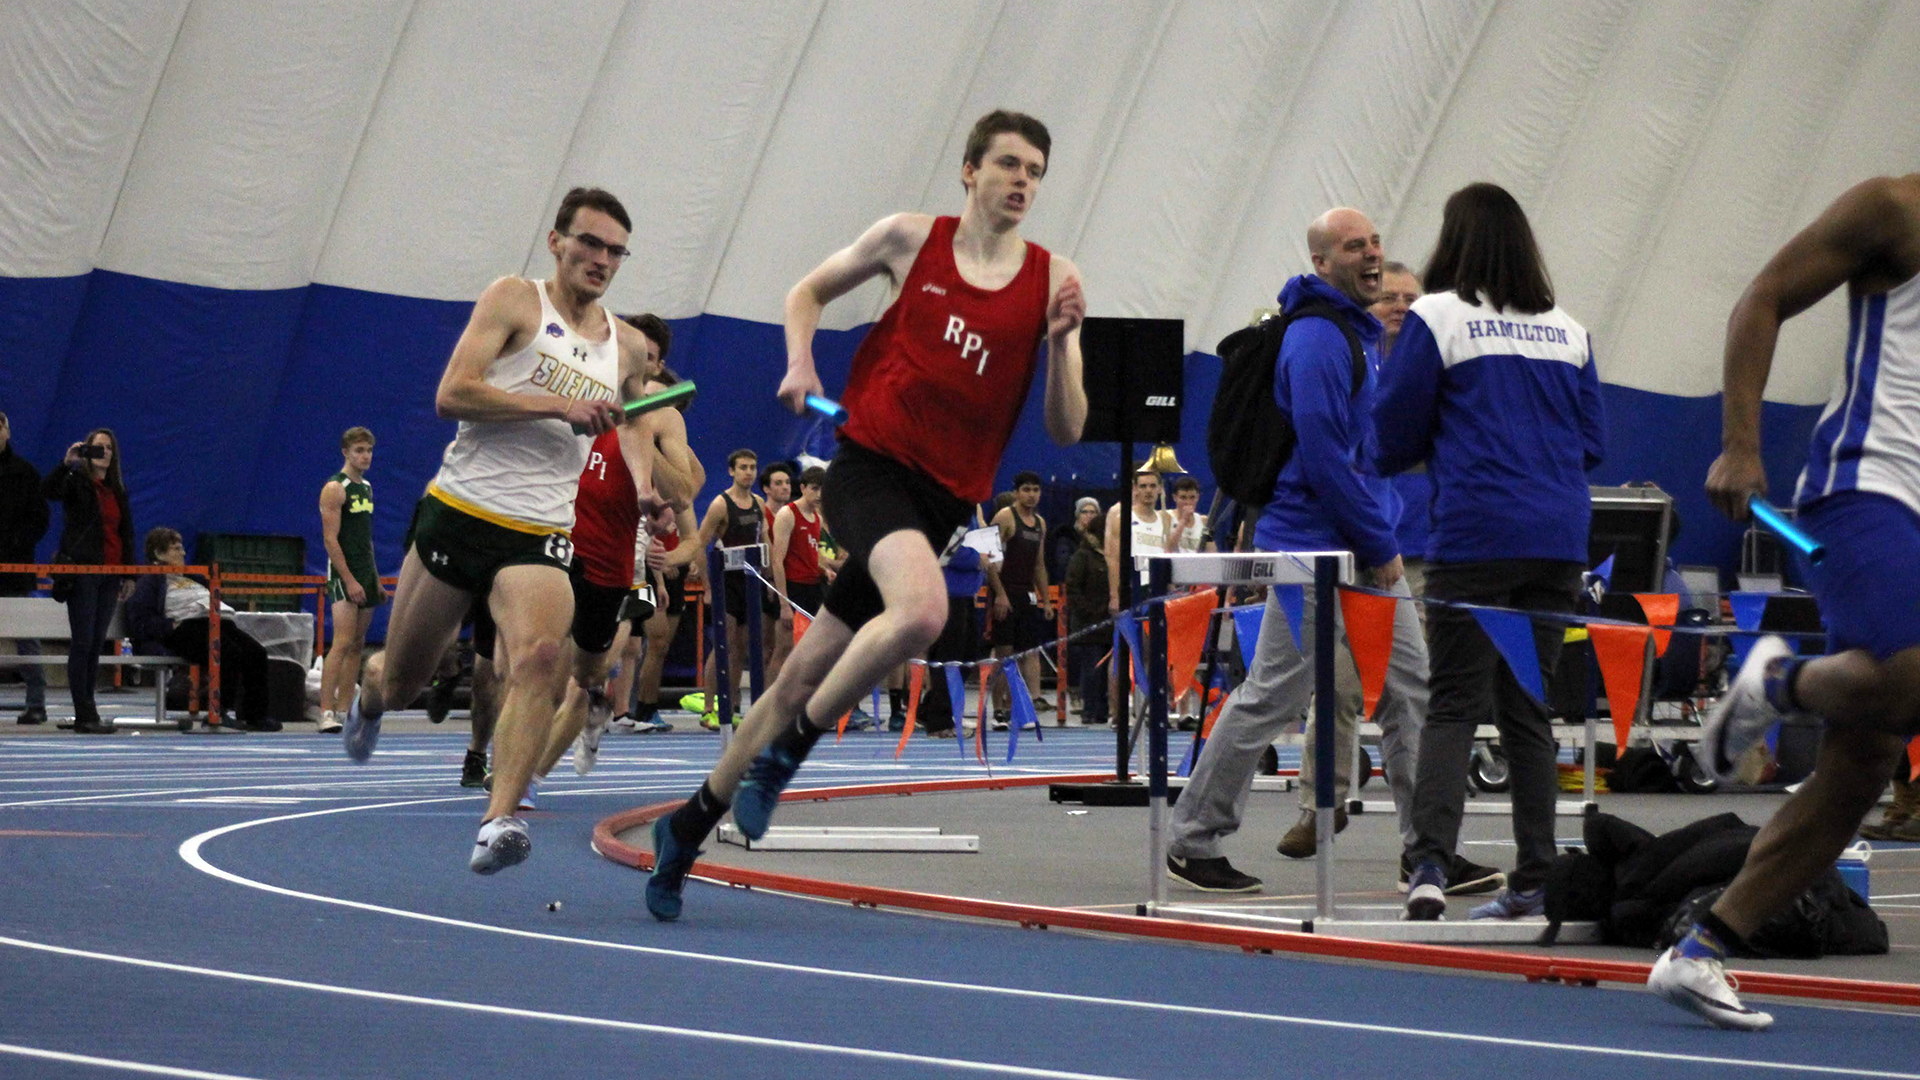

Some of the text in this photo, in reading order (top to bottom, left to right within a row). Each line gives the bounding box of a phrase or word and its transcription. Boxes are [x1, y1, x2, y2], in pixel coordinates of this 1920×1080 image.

[943, 314, 990, 376] RPI
[1466, 319, 1569, 345] HAMILTON
[1145, 395, 1176, 407] GILL
[588, 451, 607, 480] PI
[550, 532, 571, 562] 8
[1253, 562, 1274, 577] GILL
